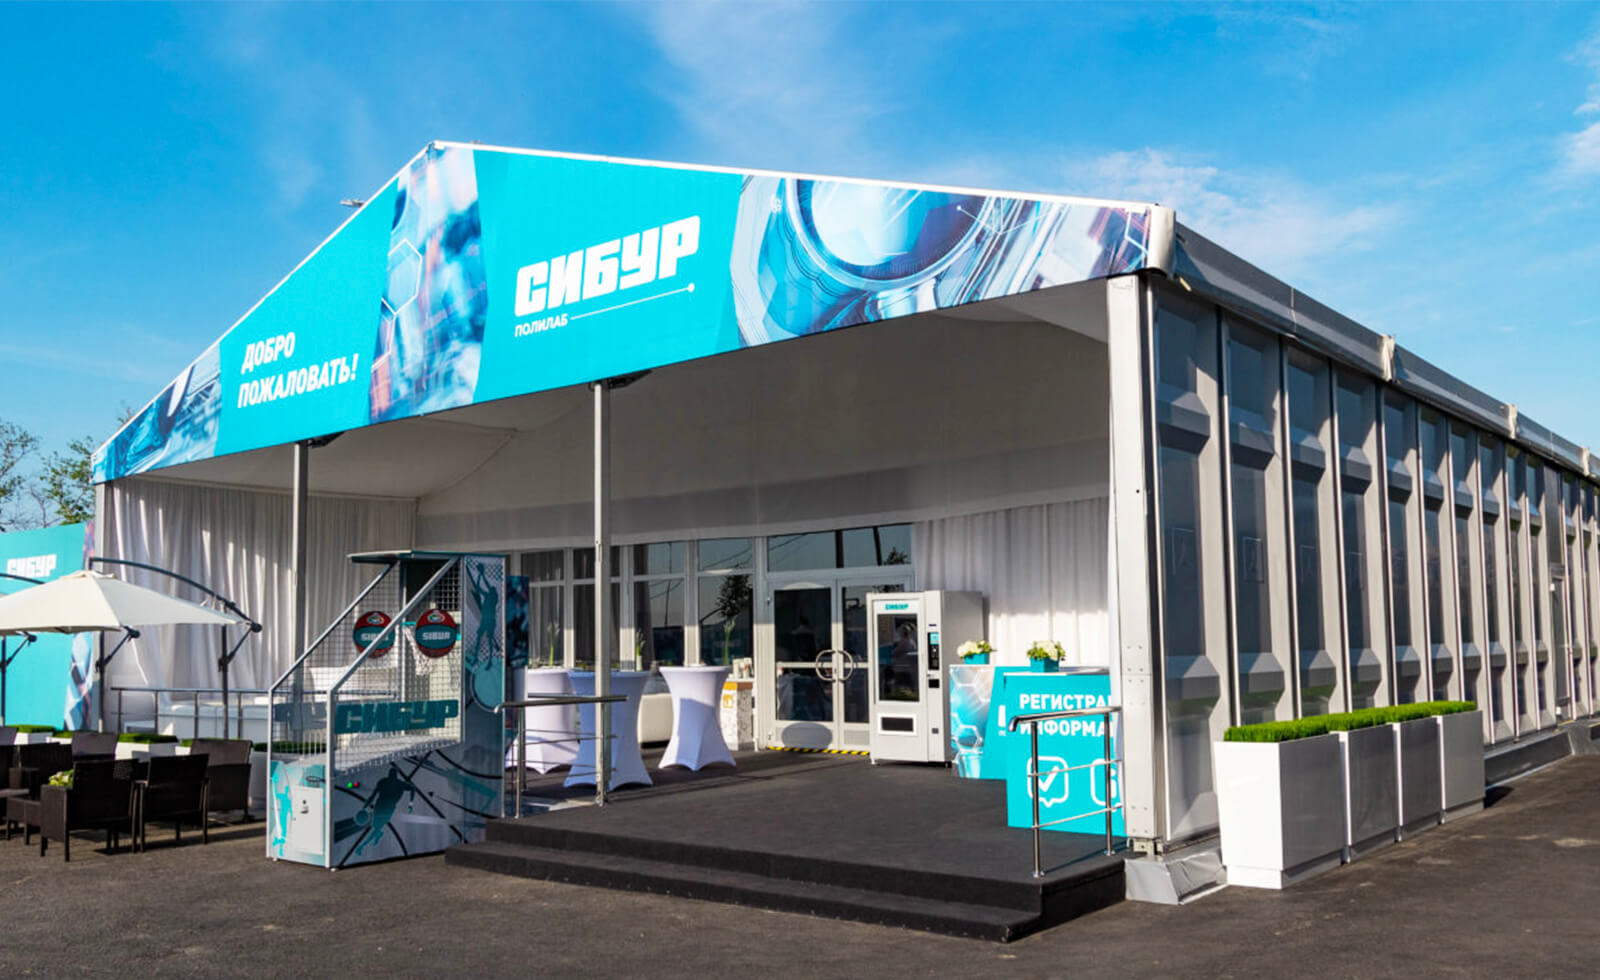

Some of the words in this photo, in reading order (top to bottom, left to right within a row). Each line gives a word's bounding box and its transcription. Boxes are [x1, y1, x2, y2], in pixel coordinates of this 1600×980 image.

[514, 215, 701, 317] СИБУР
[514, 313, 568, 338] ПОЛИЛАБ
[241, 332, 296, 375] ДОБРО
[237, 353, 359, 408] ПОЖАЛОВАТЬ!
[6, 553, 57, 578] СИБУР
[422, 631, 451, 641] SIBUR
[335, 700, 459, 734] СИБУР
